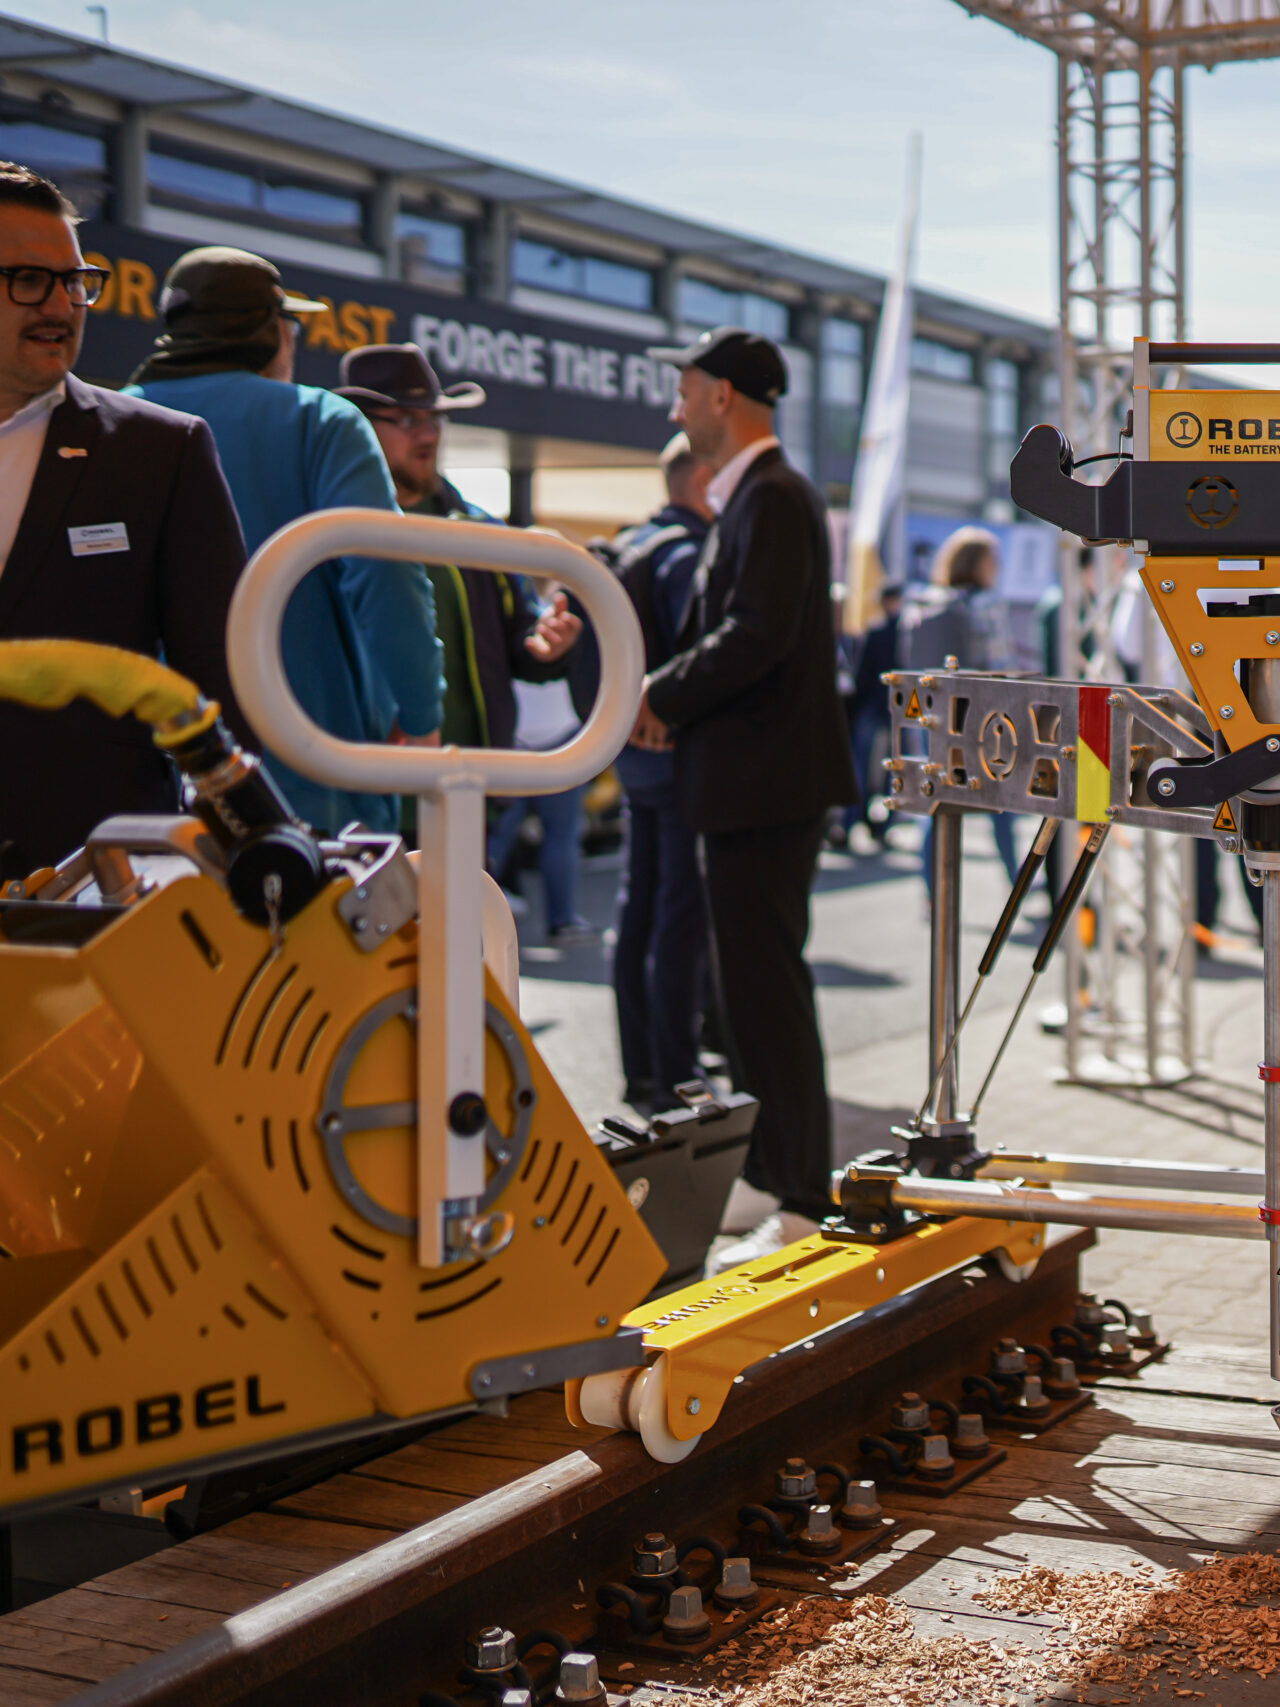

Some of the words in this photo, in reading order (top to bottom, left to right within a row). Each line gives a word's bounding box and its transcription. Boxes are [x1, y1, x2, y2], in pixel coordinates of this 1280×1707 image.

[412, 313, 545, 386] FORGE
[551, 339, 620, 399] THE
[1209, 445, 1230, 455] THE
[11, 1374, 287, 1474] ROBEL
